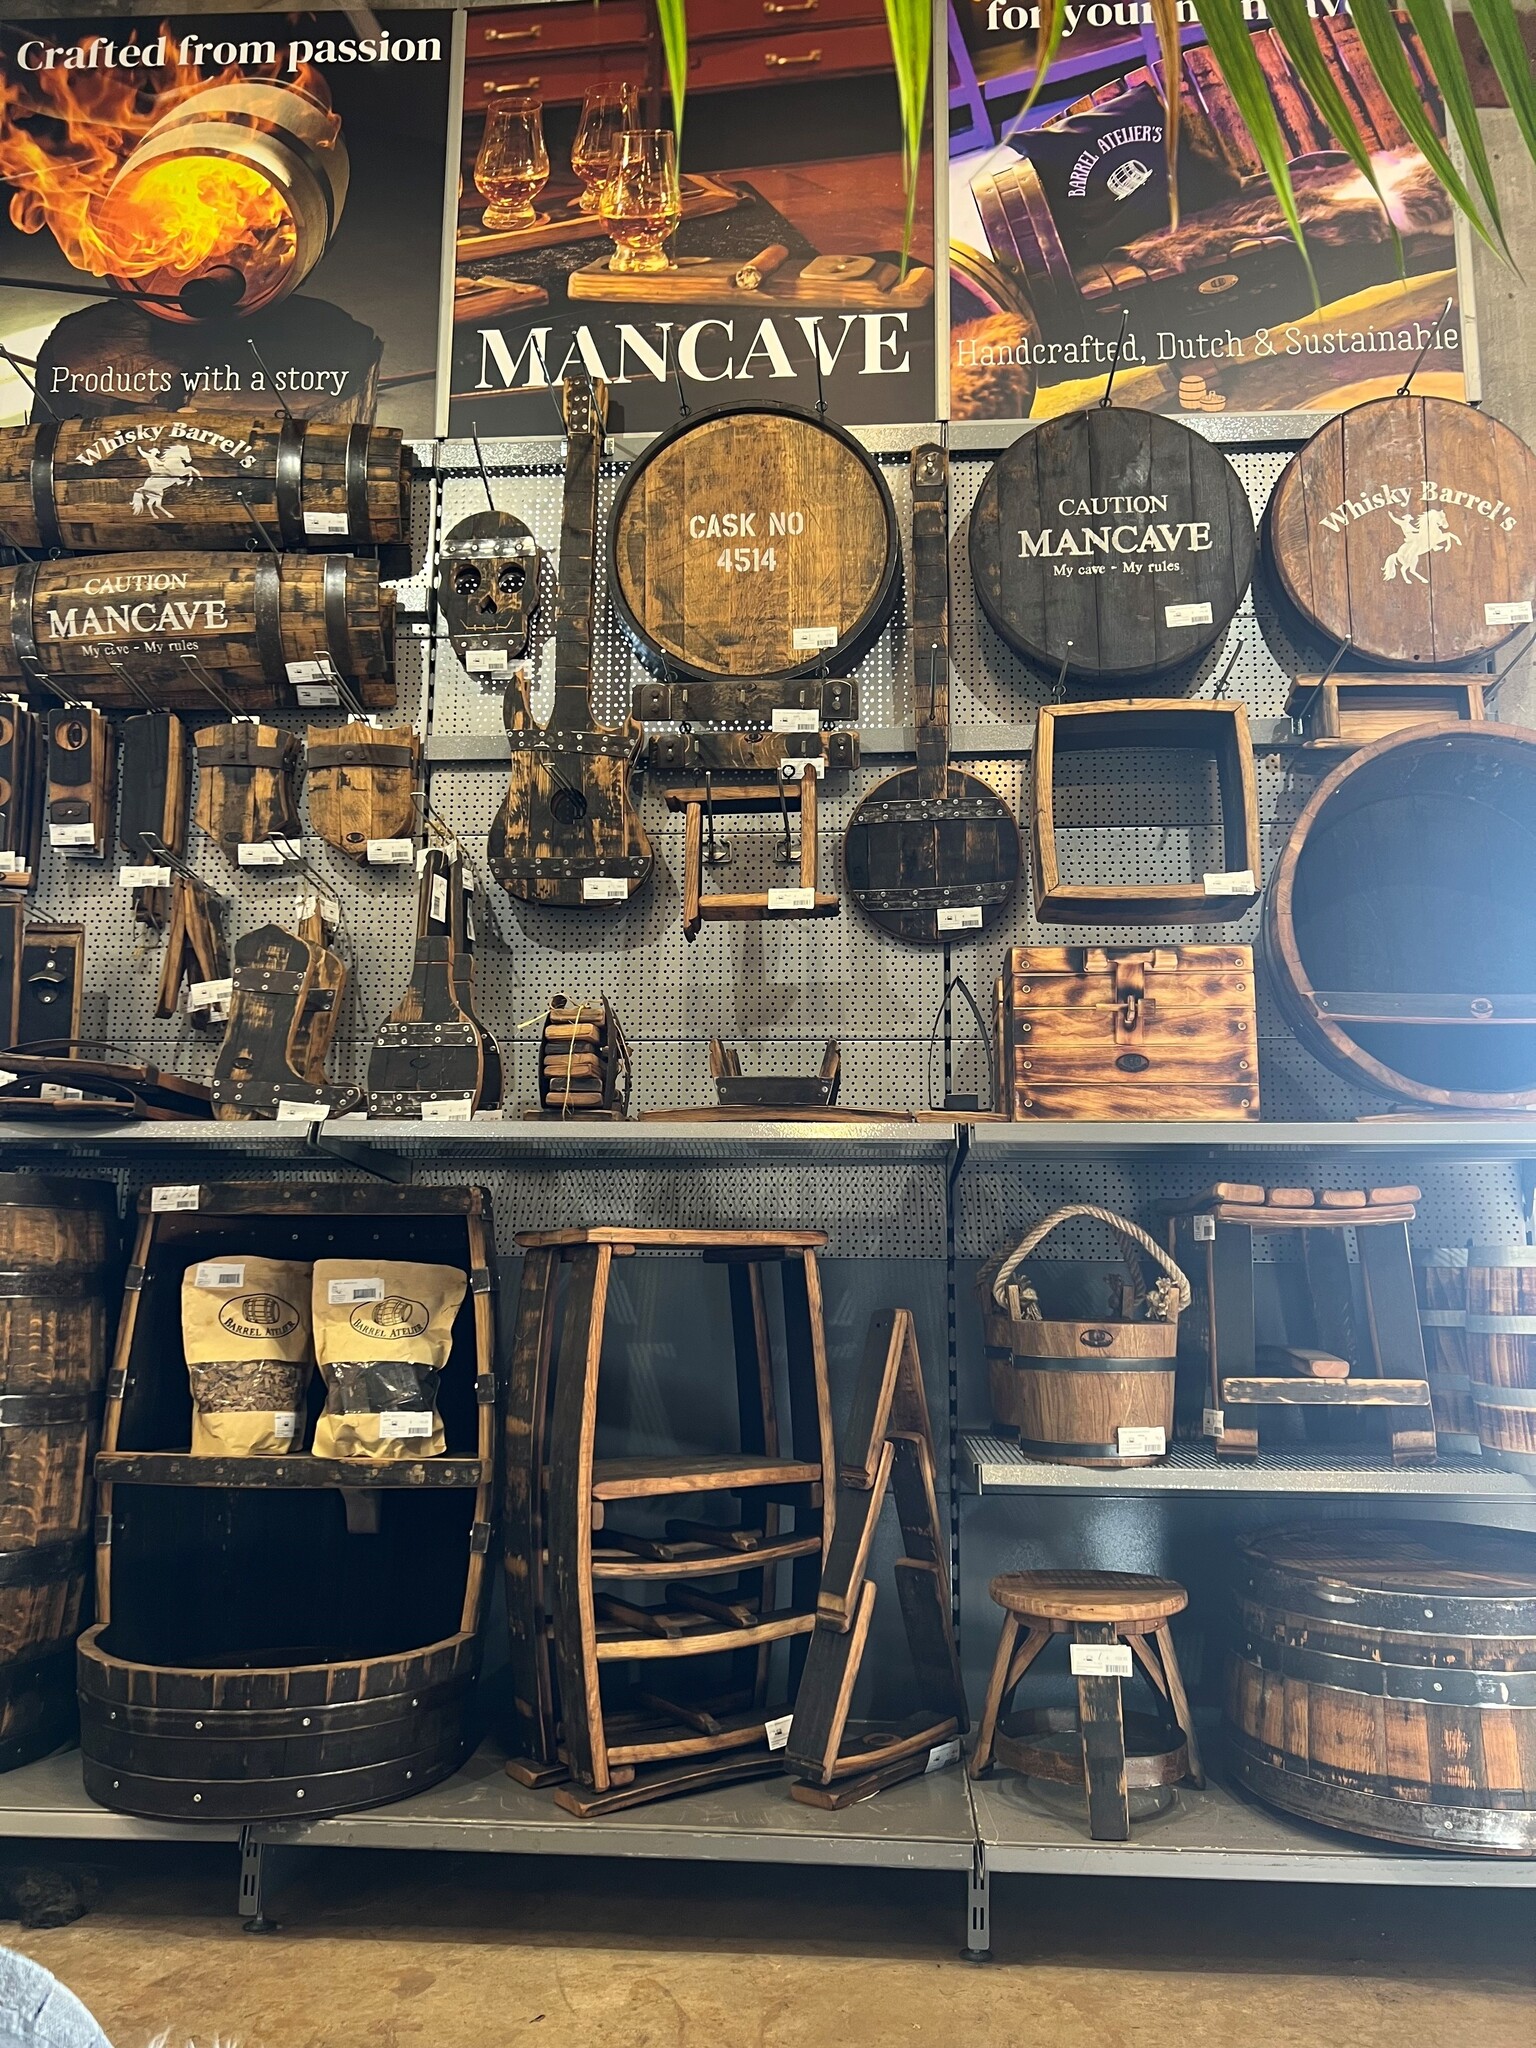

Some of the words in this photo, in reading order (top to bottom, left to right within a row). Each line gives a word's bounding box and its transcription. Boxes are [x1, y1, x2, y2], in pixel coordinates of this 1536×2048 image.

[986, 0, 1041, 30] for
[1061, 0, 1154, 37] your
[16, 35, 166, 71] Crafted
[177, 34, 277, 65] from
[286, 30, 442, 73] passion
[1068, 150, 1099, 197] BARREL
[1097, 125, 1163, 154] ATELIER'S
[475, 312, 911, 389] MANCAVE
[956, 334, 1147, 367] Handcrafted,
[1156, 329, 1245, 360] Dutch
[1254, 329, 1276, 356] &
[1285, 321, 1459, 355] Sustainable
[50, 366, 172, 393] Products
[180, 365, 241, 392] with
[251, 371, 265, 391] a
[275, 366, 350, 396] story
[75, 424, 166, 467] Whisky
[168, 421, 258, 469] Barrel's
[1058, 494, 1169, 516] CAUTION
[1319, 484, 1413, 533] Whisky
[1419, 480, 1518, 532] Barrel's
[689, 513, 756, 538] CASK
[769, 511, 804, 537] NO
[1017, 522, 1213, 558] MANCAVE
[716, 547, 777, 573] 4514
[1053, 563, 1074, 577] My
[1078, 564, 1106, 575] cave
[1122, 561, 1143, 576] My
[1148, 560, 1180, 573] rules
[84, 572, 189, 595] CAUTION
[46, 600, 229, 638] MANCAVE
[81, 644, 101, 658] My
[143, 641, 164, 655] My
[168, 640, 199, 652] rules
[224, 1317, 262, 1337] BARREL
[353, 1318, 386, 1337] BARREL
